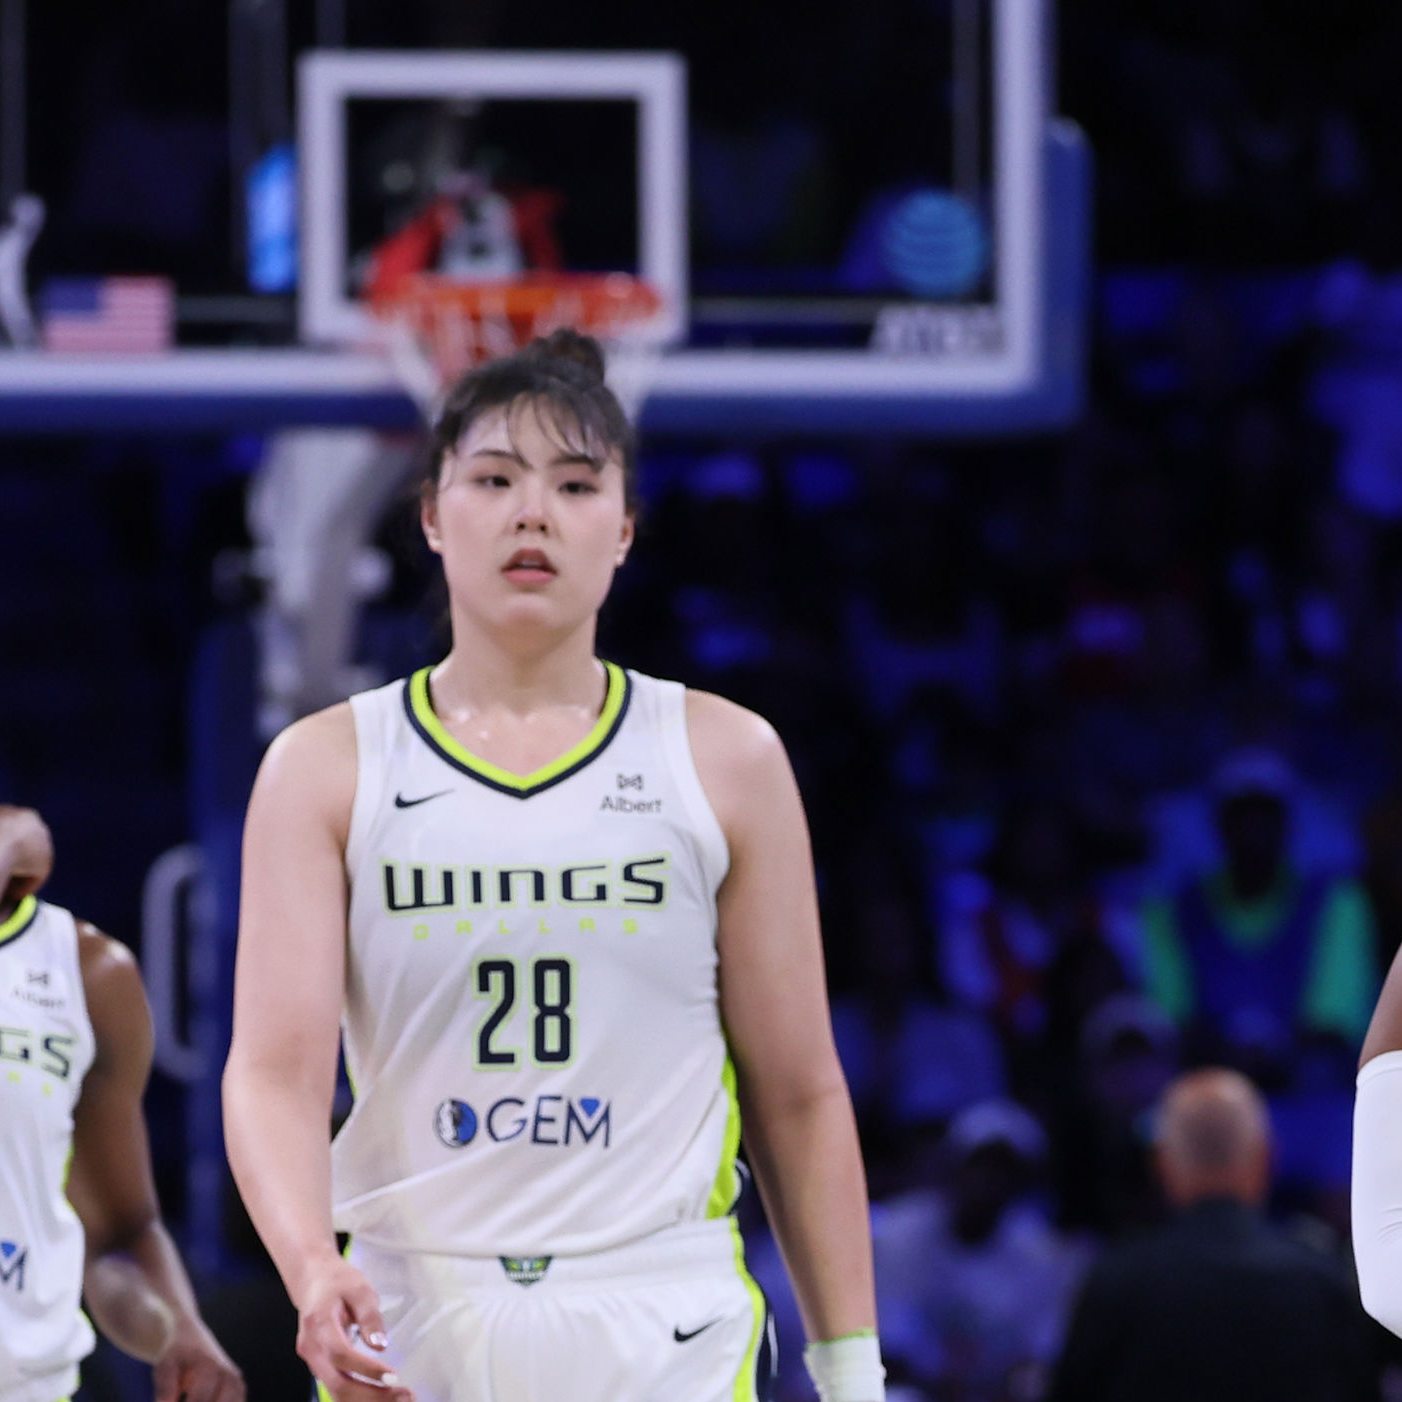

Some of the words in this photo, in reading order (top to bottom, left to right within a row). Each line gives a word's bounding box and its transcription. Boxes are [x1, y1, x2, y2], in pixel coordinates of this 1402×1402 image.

[600, 796, 662, 814] Albert
[380, 852, 671, 917] WINGS
[413, 917, 638, 940] DALLAS
[473, 954, 576, 1070] 28
[486, 1095, 611, 1148] GEM
